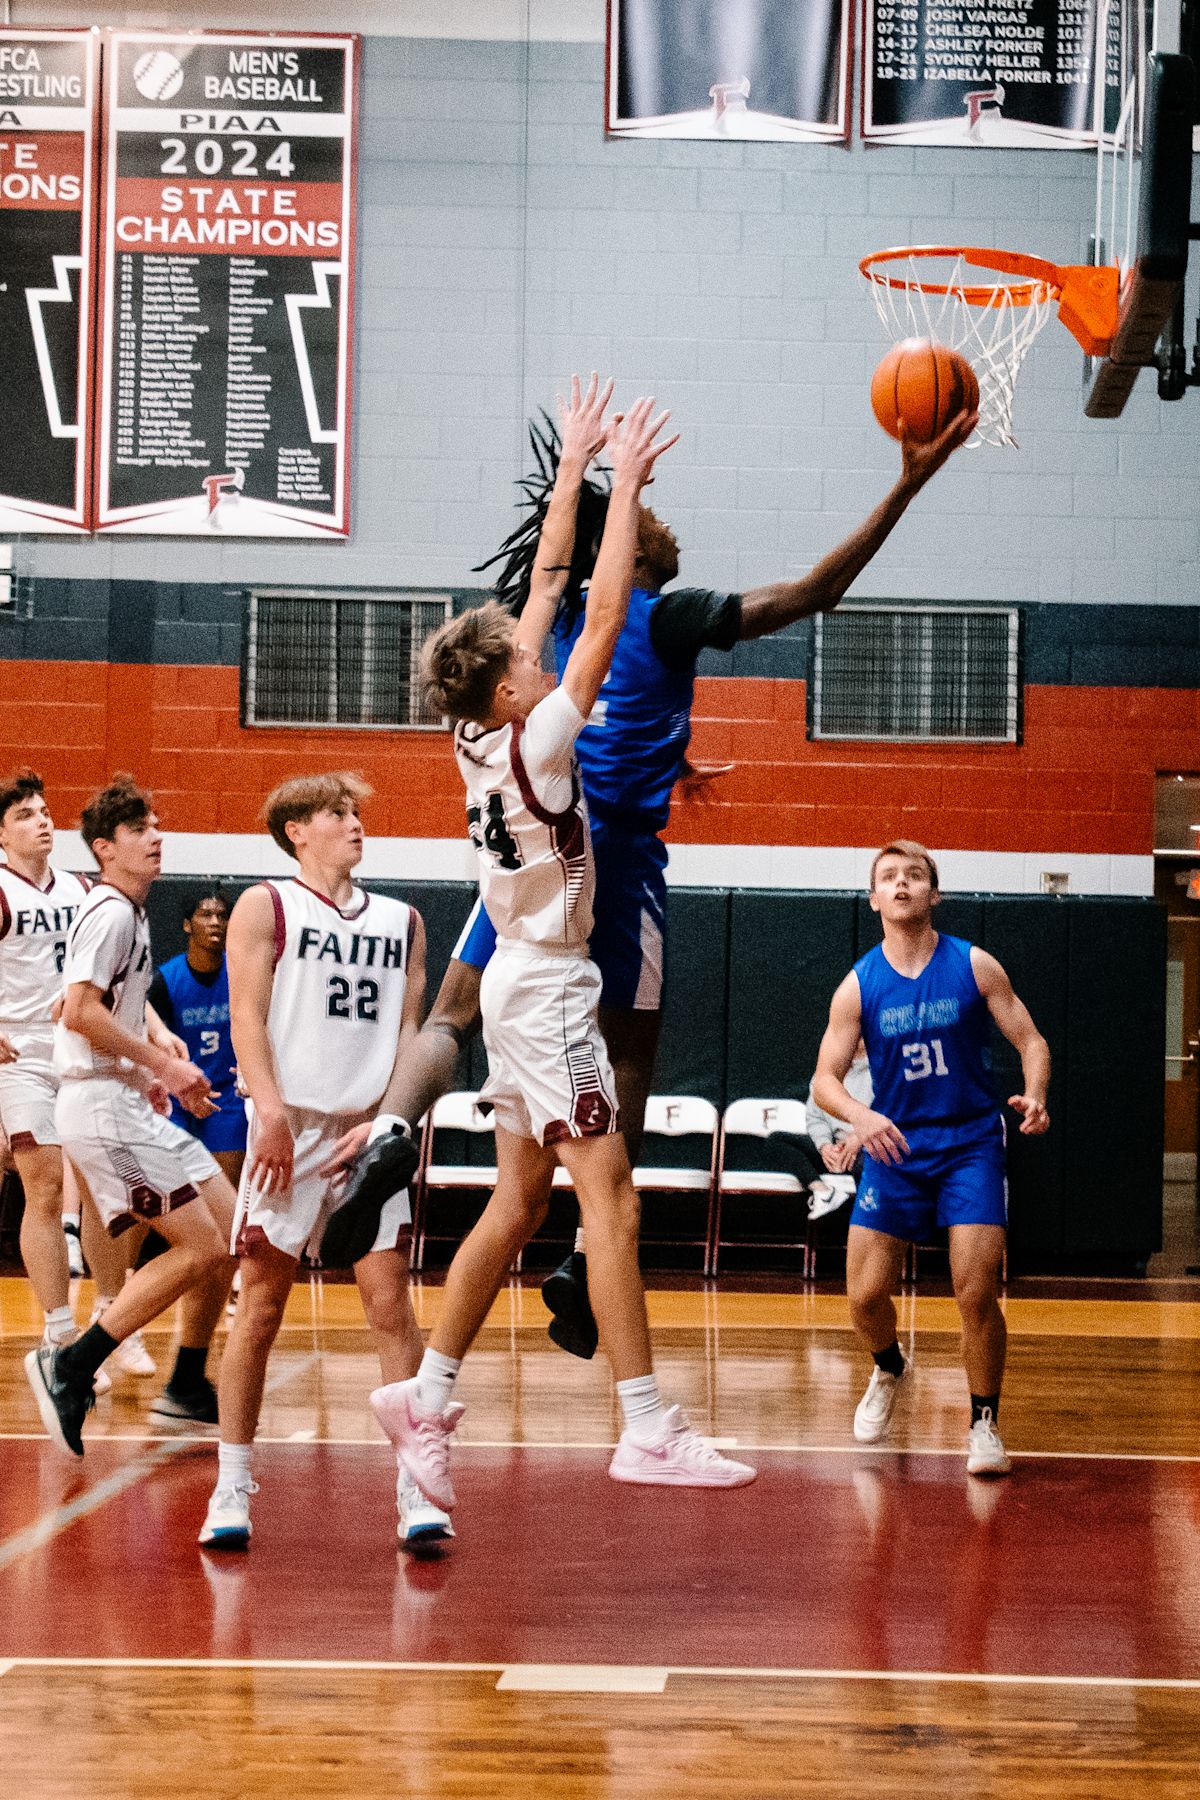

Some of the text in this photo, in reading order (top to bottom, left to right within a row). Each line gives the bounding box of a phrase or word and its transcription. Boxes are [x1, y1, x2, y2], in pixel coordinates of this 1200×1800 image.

[877, 7, 918, 20] 07-09
[926, 9, 963, 23] JOSH
[966, 10, 1028, 24] VARGAS
[877, 22, 918, 35] 07-11
[925, 23, 991, 37] CHELSEA
[994, 25, 1044, 39] NOLDE
[877, 36, 917, 50] 14-17
[924, 38, 982, 52] ASHLEY
[985, 40, 1043, 54] FORKER
[229, 51, 299, 76] MEN'S
[877, 50, 917, 64] 17-21
[924, 52, 983, 66] SYDNEY
[985, 54, 1040, 68] HELLER
[877, 65, 917, 79] 19-23
[923, 67, 992, 81] IZABELLA
[994, 69, 1051, 83] FORKER
[204, 76, 323, 102] BASEBALL
[180, 114, 282, 132] PIAA
[160, 138, 296, 178] 2024
[160, 186, 297, 216] STATE
[116, 216, 339, 247] CHAMPIONS
[298, 927, 402, 968] FAITH
[326, 974, 379, 1023] 22
[200, 1030, 220, 1057] 3
[902, 1039, 949, 1081] 31
